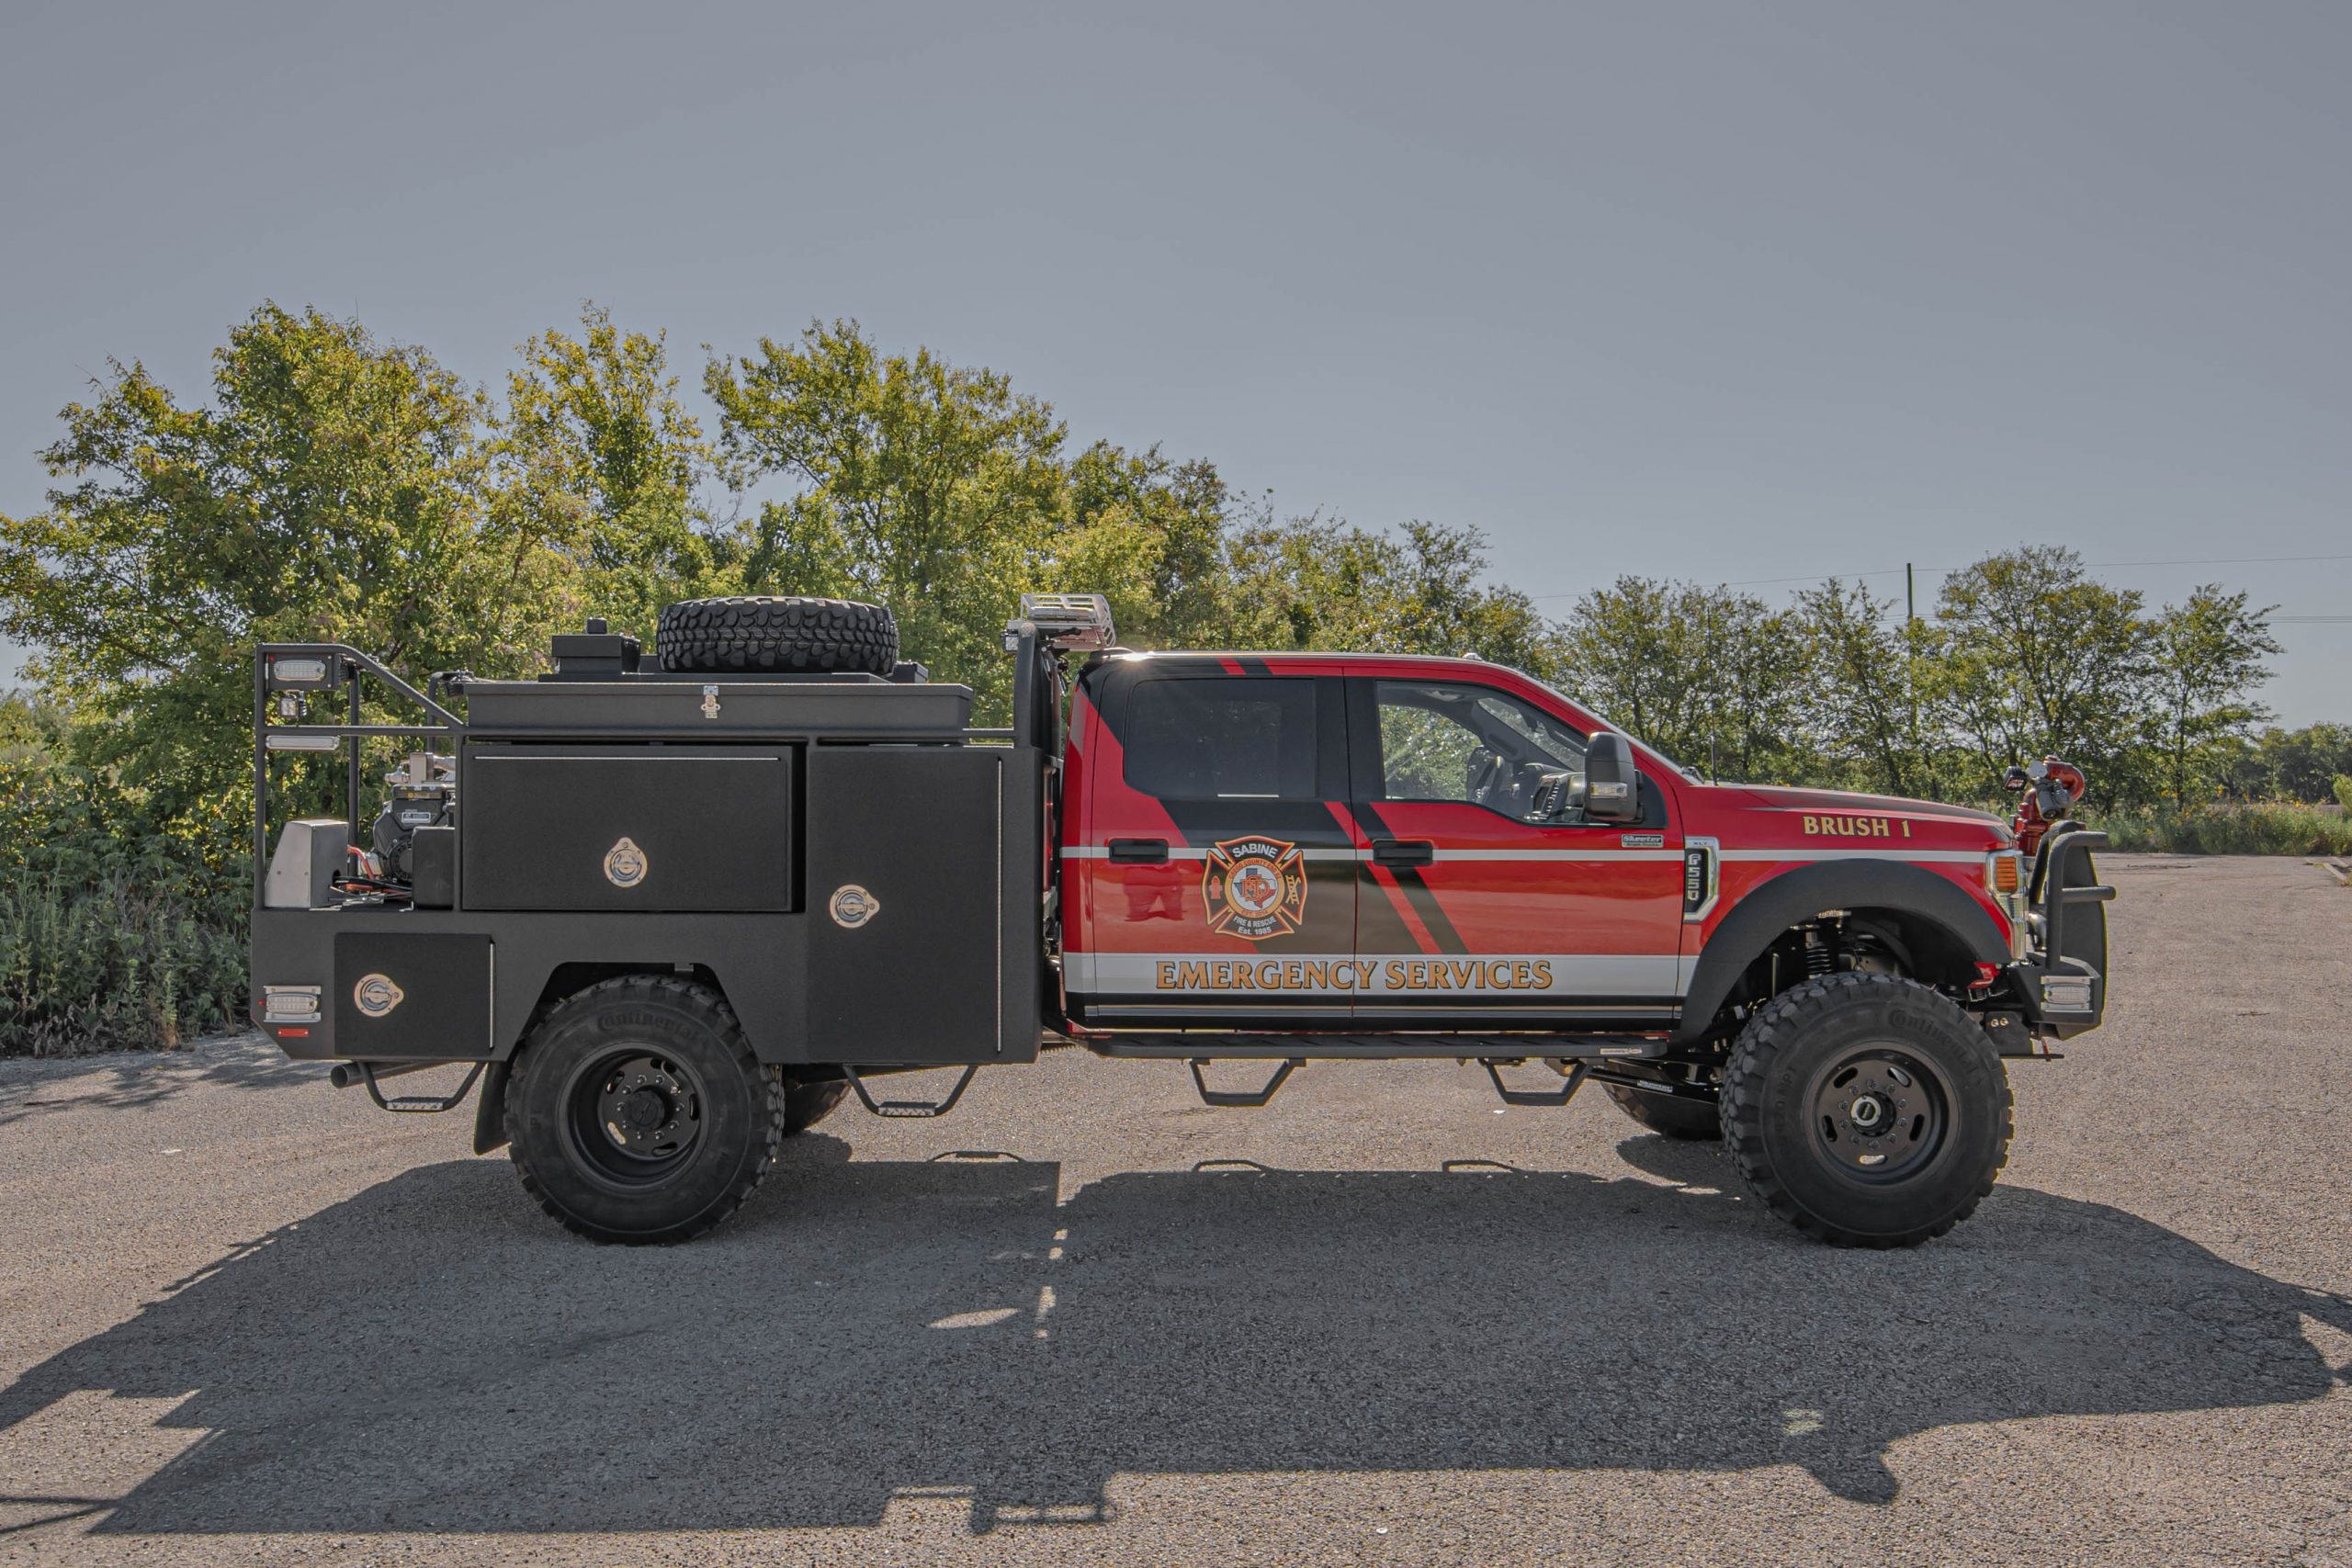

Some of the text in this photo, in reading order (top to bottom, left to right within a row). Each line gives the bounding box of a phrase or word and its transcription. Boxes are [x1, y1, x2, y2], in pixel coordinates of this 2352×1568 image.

[1803, 816, 1911, 838] BRUSH 1
[1232, 843, 1278, 858] SABINE
[1688, 853, 1702, 900] F550
[1233, 915, 1247, 926] FIRE
[1252, 916, 1276, 928] RESCUE
[1238, 926, 1252, 934] Est.
[1156, 961, 1553, 989] EMERGENCY SERVICES
